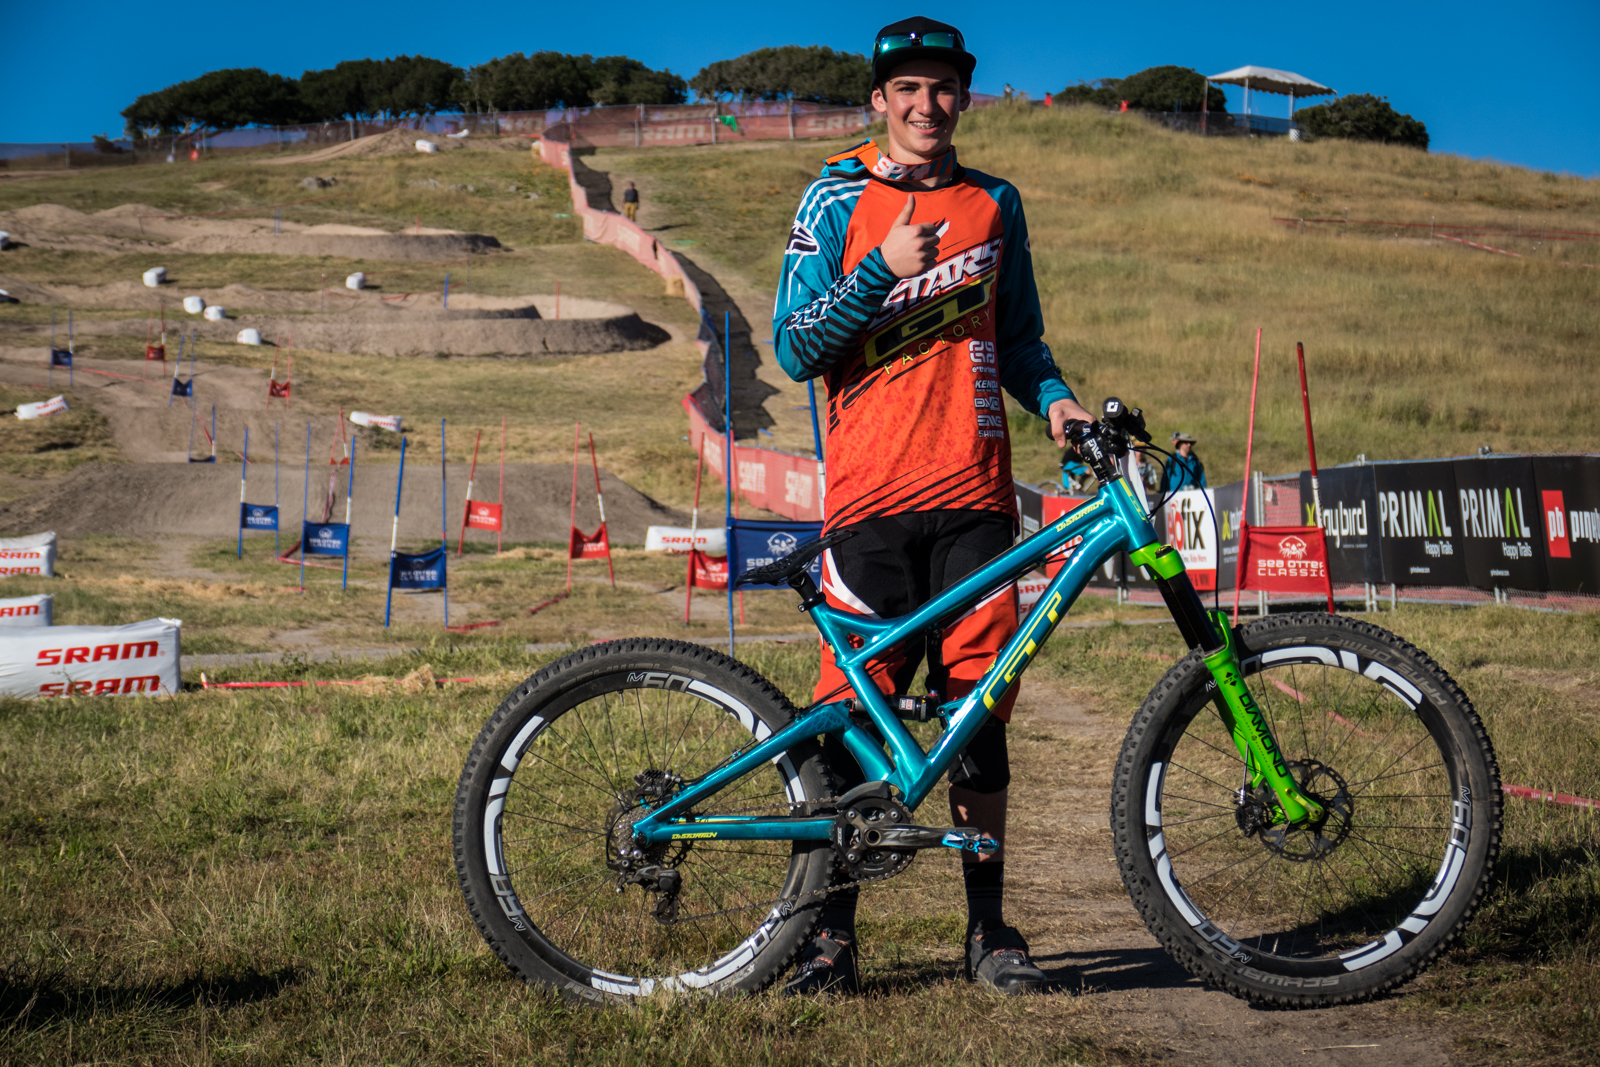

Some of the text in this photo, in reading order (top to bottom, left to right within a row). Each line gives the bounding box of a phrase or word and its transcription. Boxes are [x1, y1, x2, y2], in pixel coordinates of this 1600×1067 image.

[884, 308, 990, 375] FACTORY
[975, 380, 998, 389] KENDA
[1322, 499, 1368, 548] aybird
[1378, 490, 1453, 538] PRIMAL
[1459, 487, 1532, 538] PRIMAL
[0, 567, 41, 575] RAM
[0, 604, 39, 617] AM
[36, 641, 159, 666] SRAM
[38, 675, 161, 698] SRAM
[1239, 692, 1288, 778] DIAMOND
